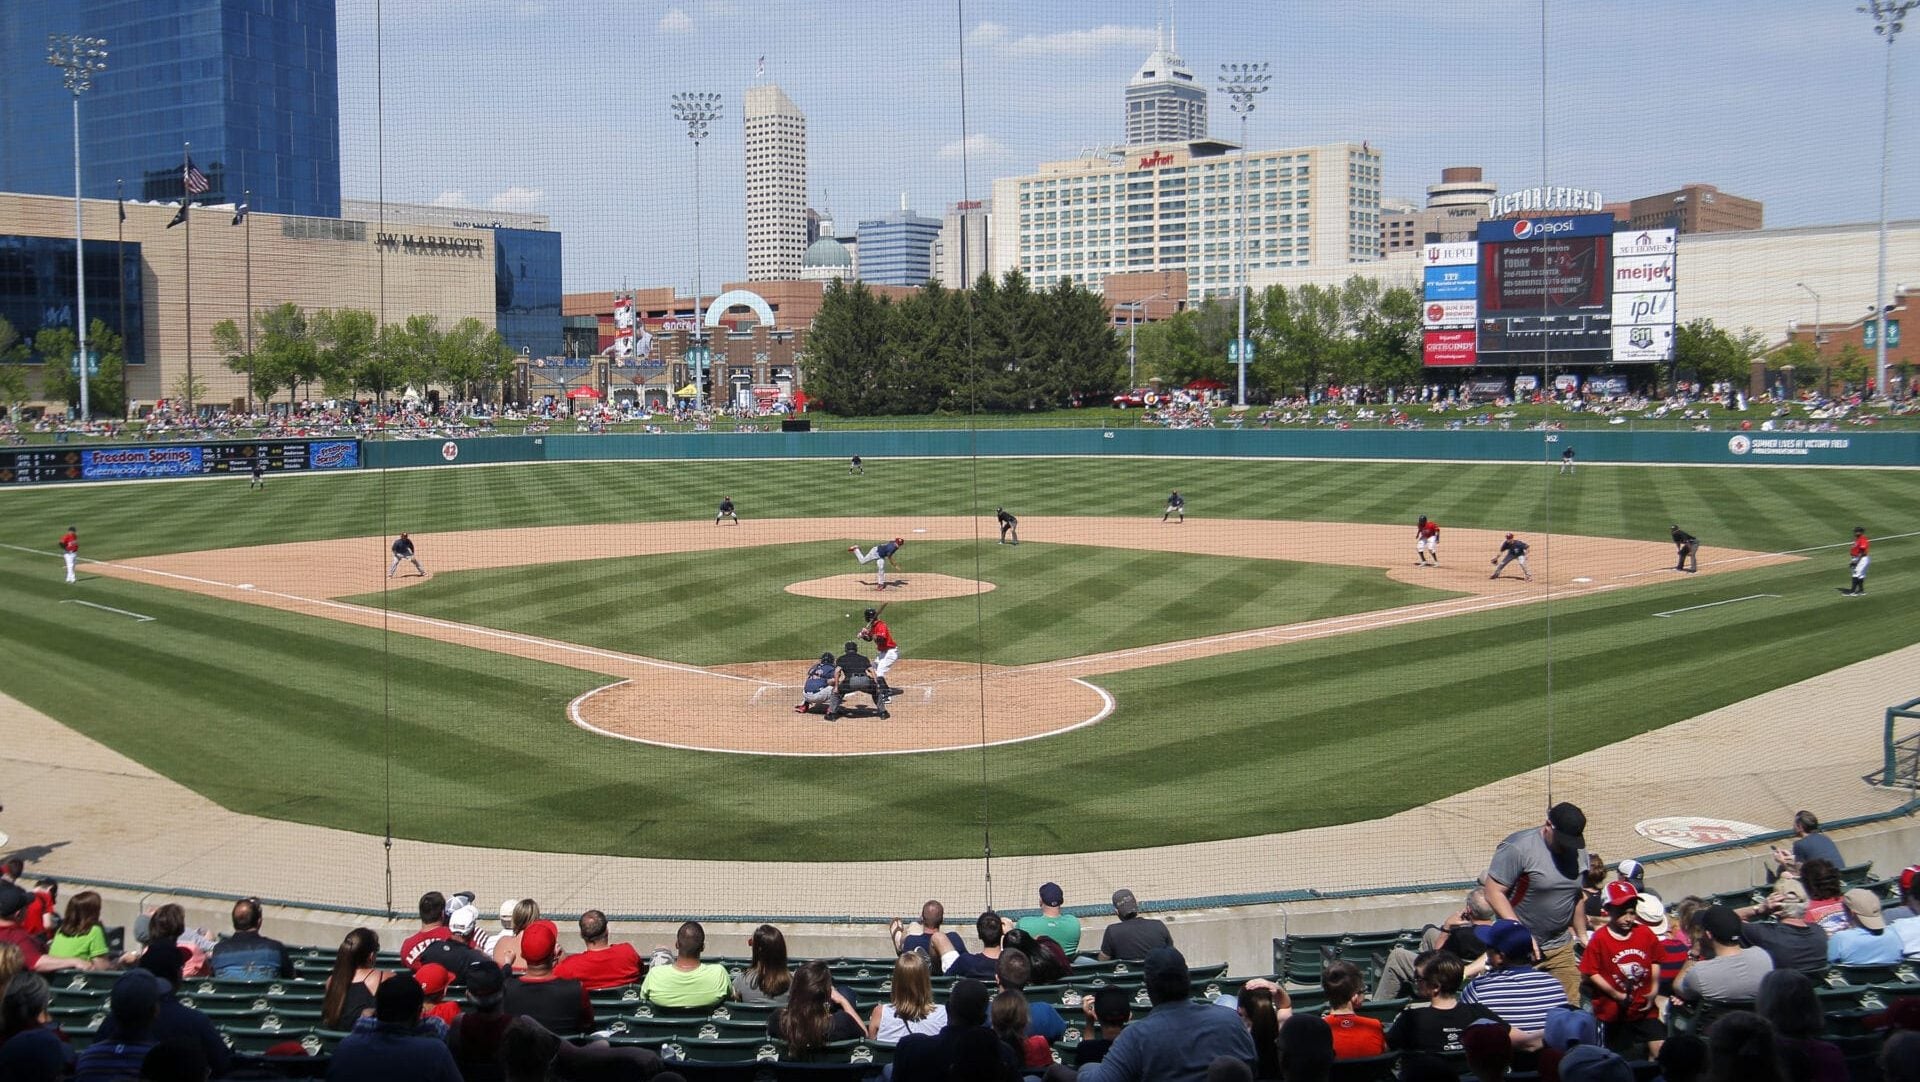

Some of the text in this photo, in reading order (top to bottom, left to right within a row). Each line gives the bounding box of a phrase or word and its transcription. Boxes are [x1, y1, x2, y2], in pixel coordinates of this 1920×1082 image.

[1488, 186, 1603, 218] VICTORY FIELD
[1534, 220, 1574, 235] pepsi
[401, 234, 484, 250] MARRIOTT
[1504, 258, 1530, 268] TODAY
[1617, 264, 1670, 281] meijer
[1631, 295, 1656, 323] ipl
[1630, 327, 1651, 341] 811
[444, 445, 457, 457] 42
[1752, 439, 1777, 448] SUMMER
[1805, 439, 1830, 448] VICTORY
[1831, 440, 1848, 448] FIELD
[92, 447, 191, 464] Freedom Springs
[84, 466, 138, 476] Greenwood
[140, 465, 178, 476] Aquatics
